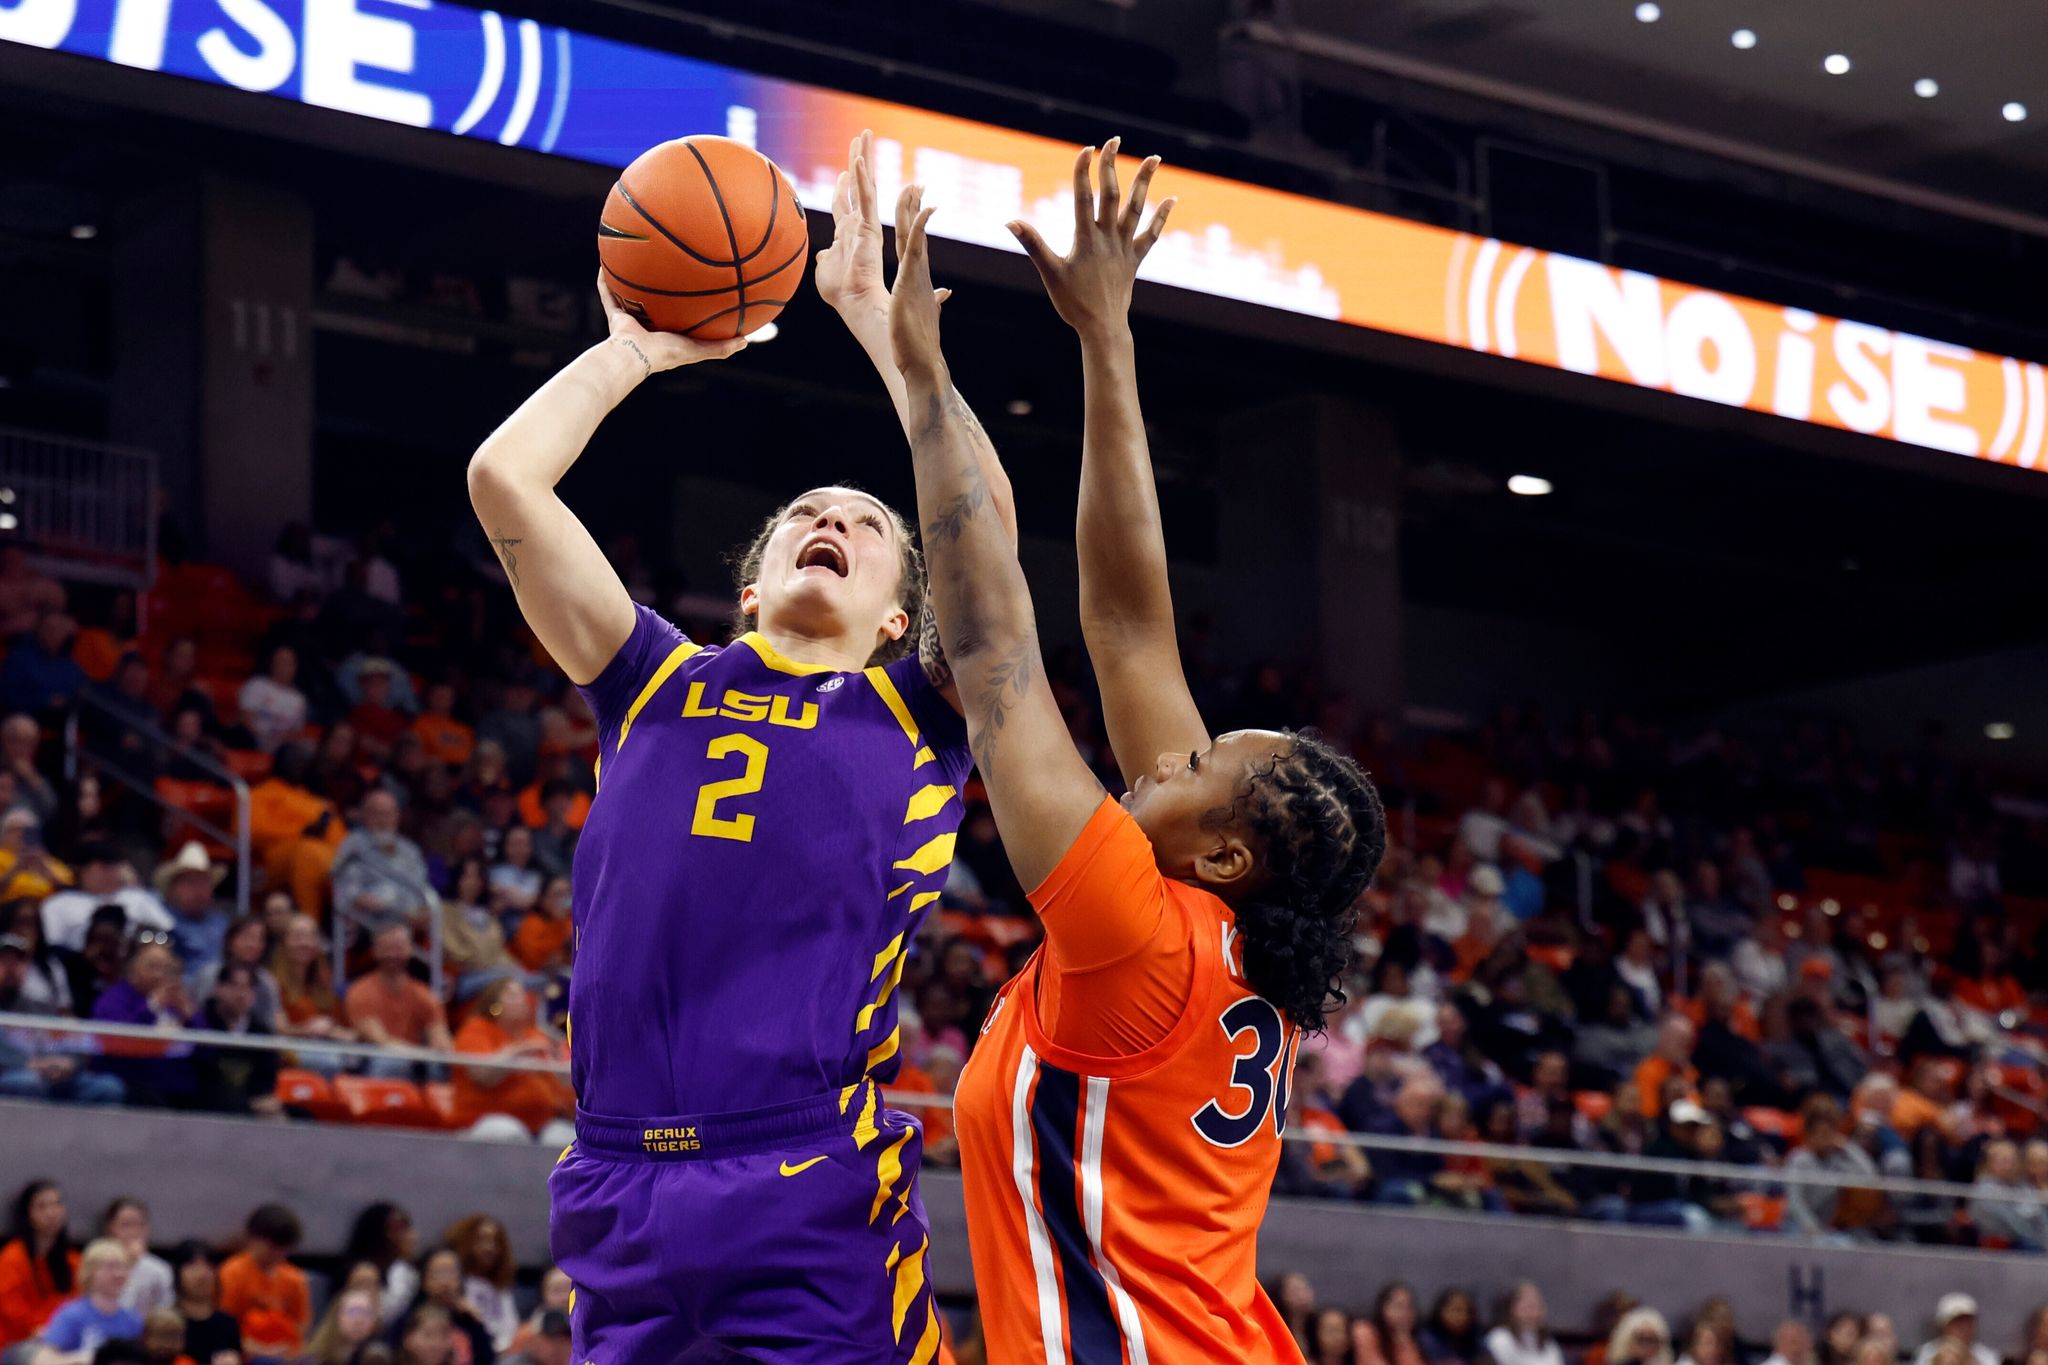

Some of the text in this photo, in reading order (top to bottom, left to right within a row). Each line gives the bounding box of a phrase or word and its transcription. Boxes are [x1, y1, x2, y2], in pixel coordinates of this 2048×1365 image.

[816, 677, 844, 692] SEC
[682, 682, 819, 729] LSU
[691, 733, 769, 842] 2
[1221, 920, 1248, 979] K
[642, 1140, 701, 1152] TIGERS
[644, 1127, 697, 1140] GEAUX
